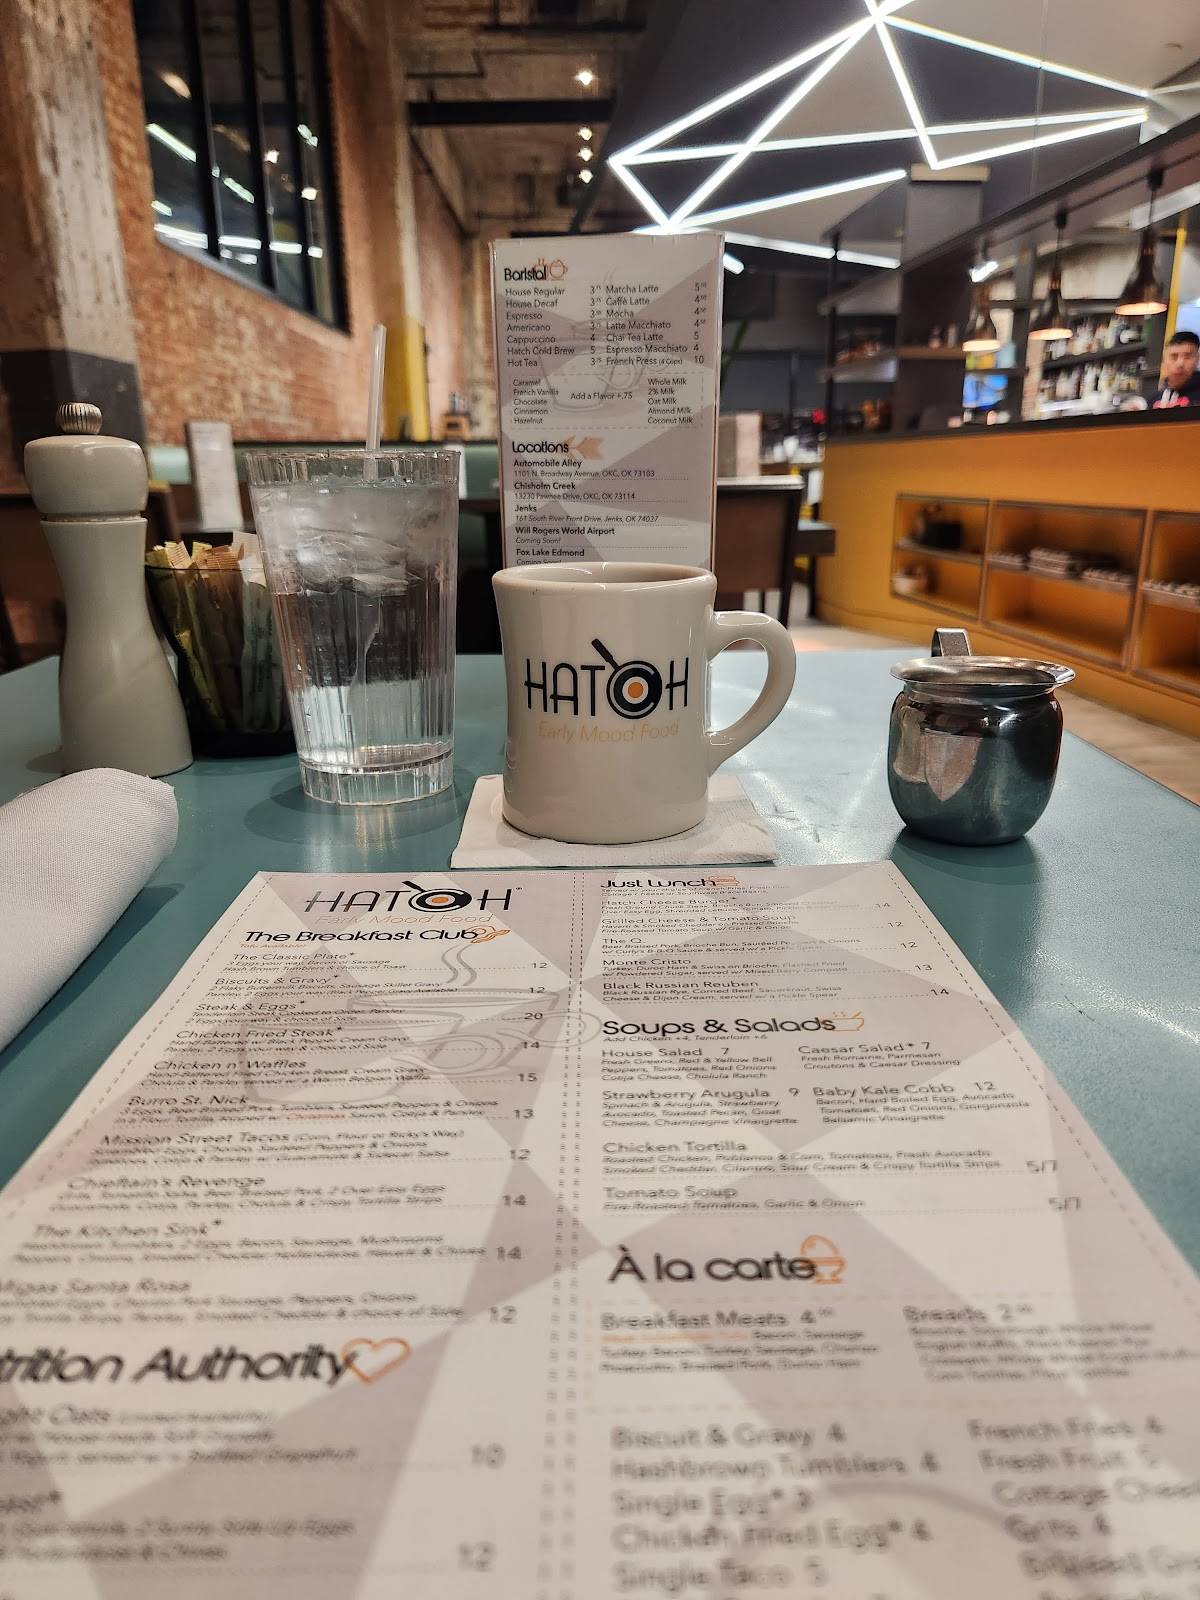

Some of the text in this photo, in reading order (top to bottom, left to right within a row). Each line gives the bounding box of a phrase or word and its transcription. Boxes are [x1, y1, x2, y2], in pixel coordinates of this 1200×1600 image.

[505, 287, 565, 297] House Regular
[606, 285, 659, 294] Matcha Latte
[506, 299, 558, 308] House Decaf
[630, 297, 650, 306] Latte
[506, 312, 543, 322] Espresso
[606, 309, 634, 318] Mocha
[507, 324, 551, 332] Americano
[606, 320, 671, 330] Latte Macchiato
[507, 336, 556, 346] Cappuccino
[606, 332, 664, 342] Chai Tea Latte
[507, 347, 575, 355] Hatch Cold Brew
[606, 344, 688, 356] Espresso Macchiato
[507, 358, 538, 367] Hot Tea
[606, 355, 704, 366] French Press 10
[647, 378, 671, 386] Whole
[513, 388, 536, 396] French
[570, 392, 615, 400] Add Flavor
[647, 388, 659, 396] 2%
[513, 398, 548, 406] Chocolate
[647, 406, 691, 415] Almond Milk
[647, 416, 693, 424] Coconut Milk
[512, 441, 569, 453] Locations
[513, 459, 583, 469] Automobile Alley
[540, 470, 572, 478] Broadway
[514, 481, 576, 490] Chisholm Creek
[601, 492, 613, 500] OK
[515, 504, 537, 512] Jenks
[515, 526, 615, 536] Will Rogers World Airport
[516, 537, 541, 545] Coming
[516, 548, 585, 557] Fox Lake Edmond
[537, 720, 680, 743] Early Mood Food
[600, 878, 717, 888] Just Lunch
[315, 913, 494, 925] Early Mood Food
[762, 914, 797, 923] Soup
[244, 929, 479, 942] The Breakfast Club
[232, 953, 262, 961] The
[262, 953, 311, 961] Classic
[914, 964, 934, 972] 13
[215, 977, 270, 985] Biscuits
[273, 977, 285, 985] &
[529, 986, 546, 994] 12
[602, 980, 950, 997] Black Russian Reuben 14
[196, 1002, 239, 1011] Steak
[242, 1002, 253, 1011] &
[524, 1012, 543, 1020] 20
[602, 1017, 837, 1037] Soups & Salads
[176, 1030, 242, 1040] Chicken
[246, 1029, 288, 1039] Fried
[522, 1041, 540, 1049] 14
[601, 1047, 730, 1058] House Salad 7
[798, 1045, 853, 1054] Caesar
[921, 1042, 931, 1050] 7
[153, 1059, 308, 1071] Chicken Waffles
[602, 1087, 800, 1101] Strawberry Arugula 9
[812, 1081, 996, 1099] Baby Kale Cobb 12
[602, 1140, 748, 1153] Chicken Tortilla
[603, 1185, 739, 1200] Tomato Soup
[608, 1245, 818, 1284] À la carte
[601, 1307, 790, 1331] Breakfast Meats
[133, 1343, 360, 1387] Authority
